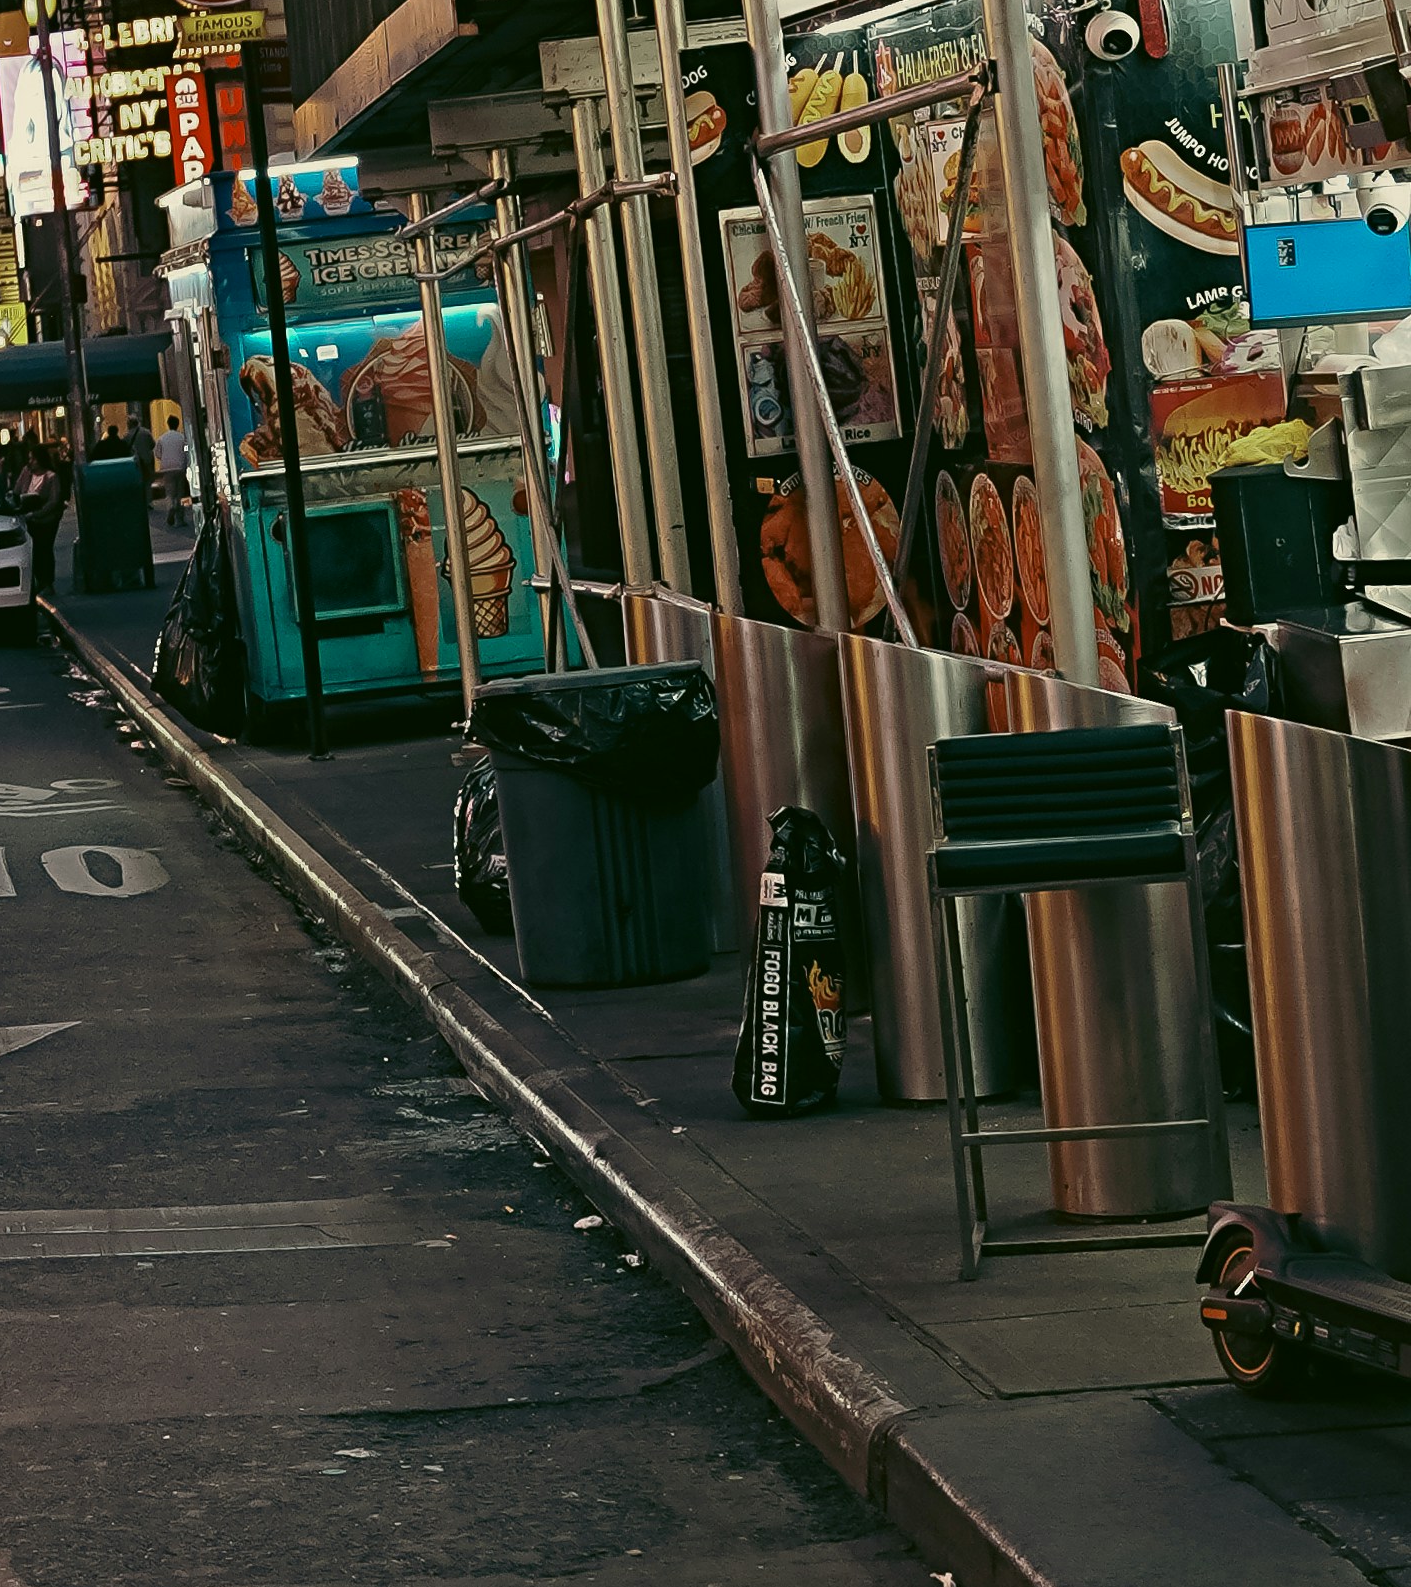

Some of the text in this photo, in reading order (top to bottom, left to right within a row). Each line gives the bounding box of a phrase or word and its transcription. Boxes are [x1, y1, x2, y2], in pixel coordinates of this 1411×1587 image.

[195, 15, 253, 32] FAMOUS
[188, 28, 263, 44] CHEESECAKE
[895, 47, 930, 87] HALAL
[931, 41, 960, 75] FRESH
[682, 65, 708, 89] DOG
[1165, 117, 1229, 172] JUMPO HO
[849, 234, 870, 248] NY
[305, 245, 371, 267] TIMES
[312, 266, 354, 286] ICE
[845, 428, 871, 440] Rice
[763, 950, 781, 996] FOGO
[761, 1001, 779, 1057] BLACK
[760, 1061, 778, 1097] BAG
